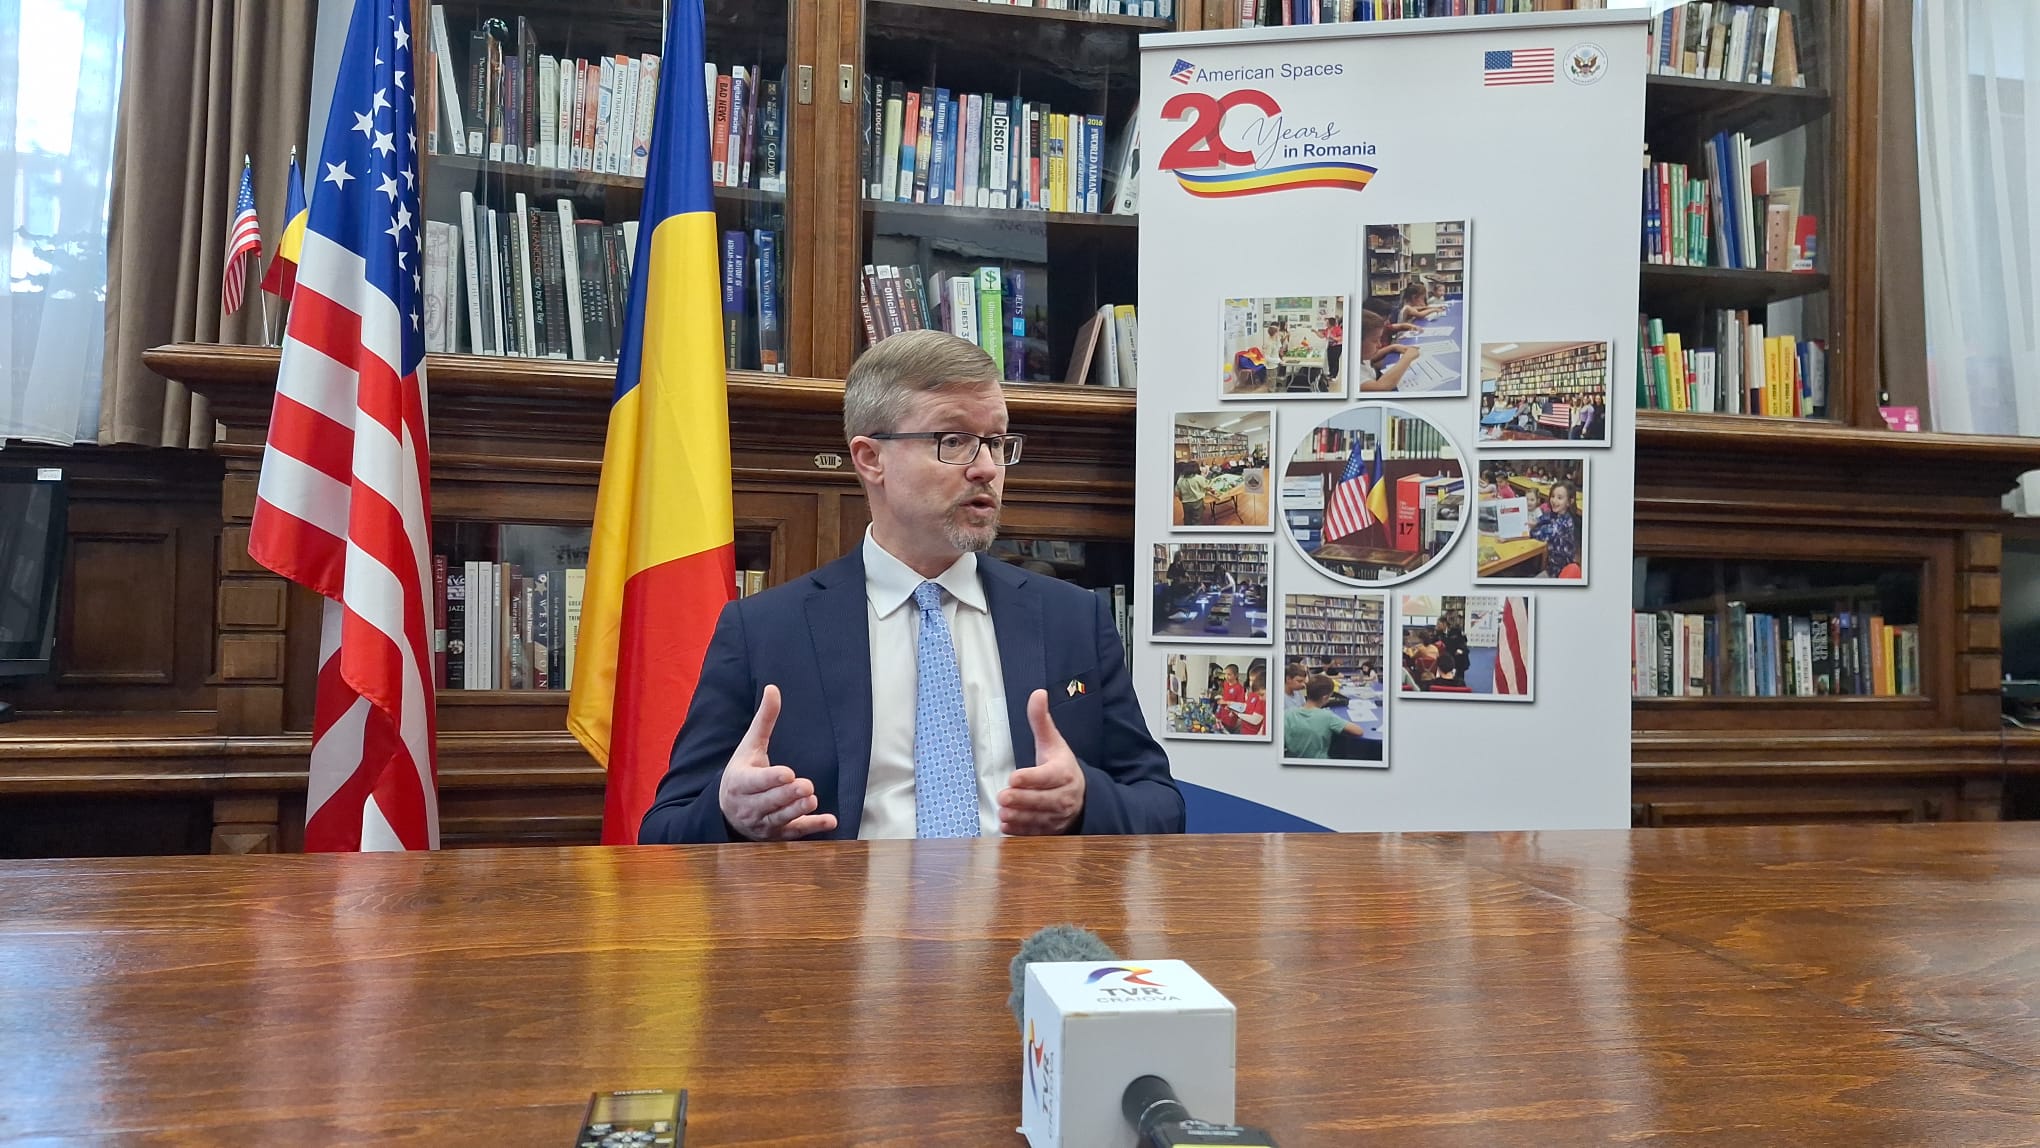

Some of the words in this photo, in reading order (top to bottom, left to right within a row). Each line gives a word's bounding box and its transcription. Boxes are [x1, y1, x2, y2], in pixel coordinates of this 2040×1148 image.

[616, 70, 624, 95] HUMAN
[1196, 66, 1274, 83] American
[1280, 63, 1344, 81] Spaces
[719, 83, 728, 98] BAD
[733, 79, 742, 101] Digital
[613, 96, 622, 137] TRAFFICKING
[717, 100, 727, 122] NEWS
[732, 102, 741, 133] Literacies
[1087, 118, 1103, 127] 2016
[1157, 88, 1283, 170] 20
[1241, 115, 1341, 170] Years
[993, 118, 1008, 152] Cisco
[1089, 133, 1099, 163] WORLD
[1283, 144, 1299, 159] in
[1303, 141, 1377, 158] Romania
[530, 210, 539, 228] SAN
[532, 230, 543, 276] FRANCISCO
[534, 276, 543, 289] City
[535, 290, 544, 299] by
[537, 300, 545, 311] the
[595, 280, 603, 322] THOUSAND
[884, 287, 898, 317] Official
[1015, 294, 1023, 315] IELTS
[536, 312, 545, 325] Bay
[1399, 523, 1414, 536] 17
[511, 596, 520, 632] American
[539, 598, 547, 639] WEST
[1099, 987, 1164, 996] TVR
